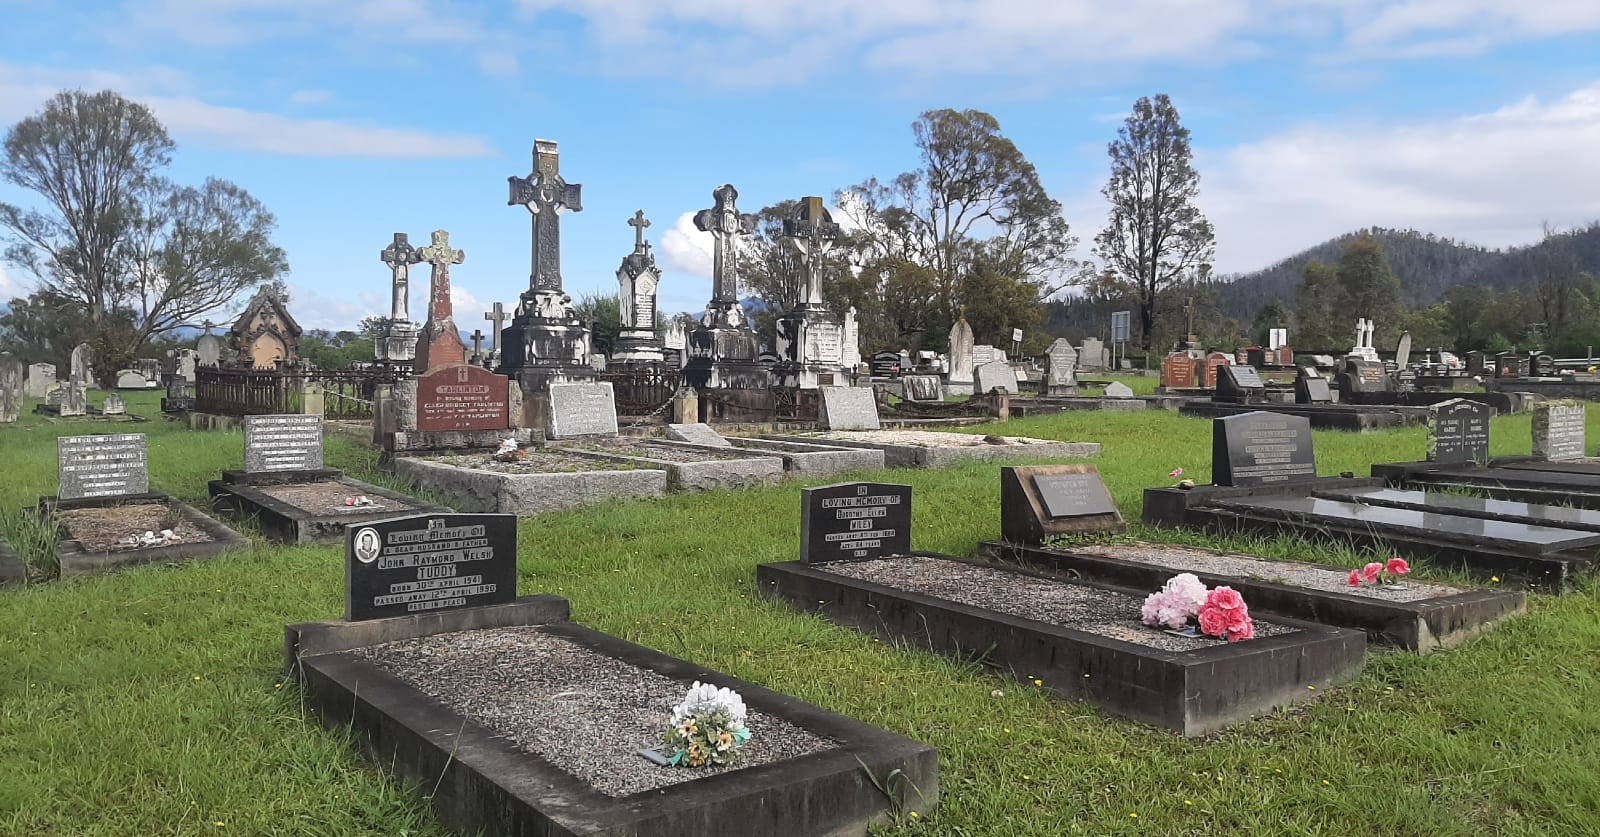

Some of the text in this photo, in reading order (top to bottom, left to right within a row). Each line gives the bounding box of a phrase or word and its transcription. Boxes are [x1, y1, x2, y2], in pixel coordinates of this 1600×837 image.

[858, 486, 867, 495] IN
[823, 495, 899, 508] LOVING MEMORY OF
[431, 520, 443, 529] In
[390, 533, 424, 543] Loving
[430, 529, 466, 540] Memory
[395, 545, 414, 553] DEAR
[417, 542, 451, 551] HUSBAND
[462, 539, 487, 547] FATHER
[420, 565, 456, 579] TUDDY
[391, 585, 412, 593] BORN
[439, 578, 460, 587] APRIL
[464, 575, 481, 584] 1941
[375, 596, 404, 605] PASSED
[408, 594, 427, 602] AWAY
[452, 587, 472, 595] APRIL
[409, 602, 427, 610] REST
[442, 598, 465, 606] PEACE
